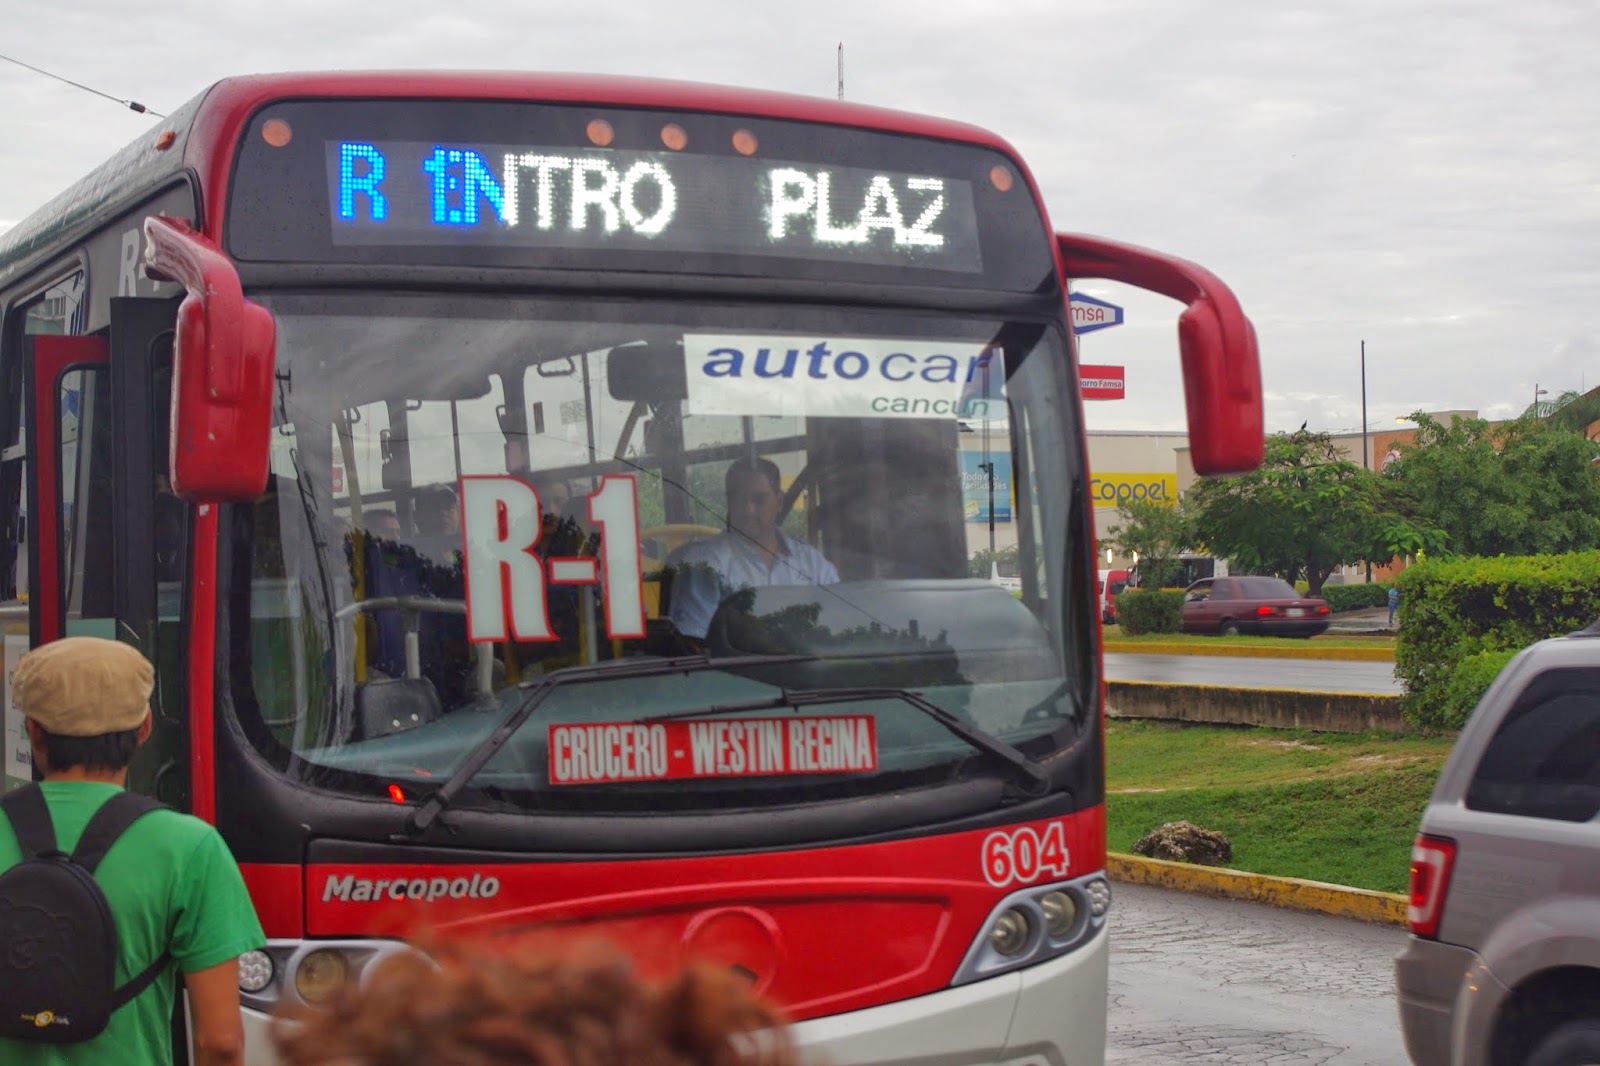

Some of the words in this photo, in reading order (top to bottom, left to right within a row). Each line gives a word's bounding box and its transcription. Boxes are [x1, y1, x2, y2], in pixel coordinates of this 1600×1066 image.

[768, 167, 945, 246] PLAZ
[702, 341, 993, 383] autocar
[1098, 380, 1122, 388] Famsa
[962, 472, 982, 481] Todo
[1090, 479, 1168, 505] Coppel
[459, 474, 646, 642] R-1
[553, 723, 668, 781] CRUCERO
[688, 719, 784, 775] WESTIN
[788, 717, 874, 771] REGINA
[982, 821, 1070, 888] 604
[322, 872, 500, 902] Marcopolo
